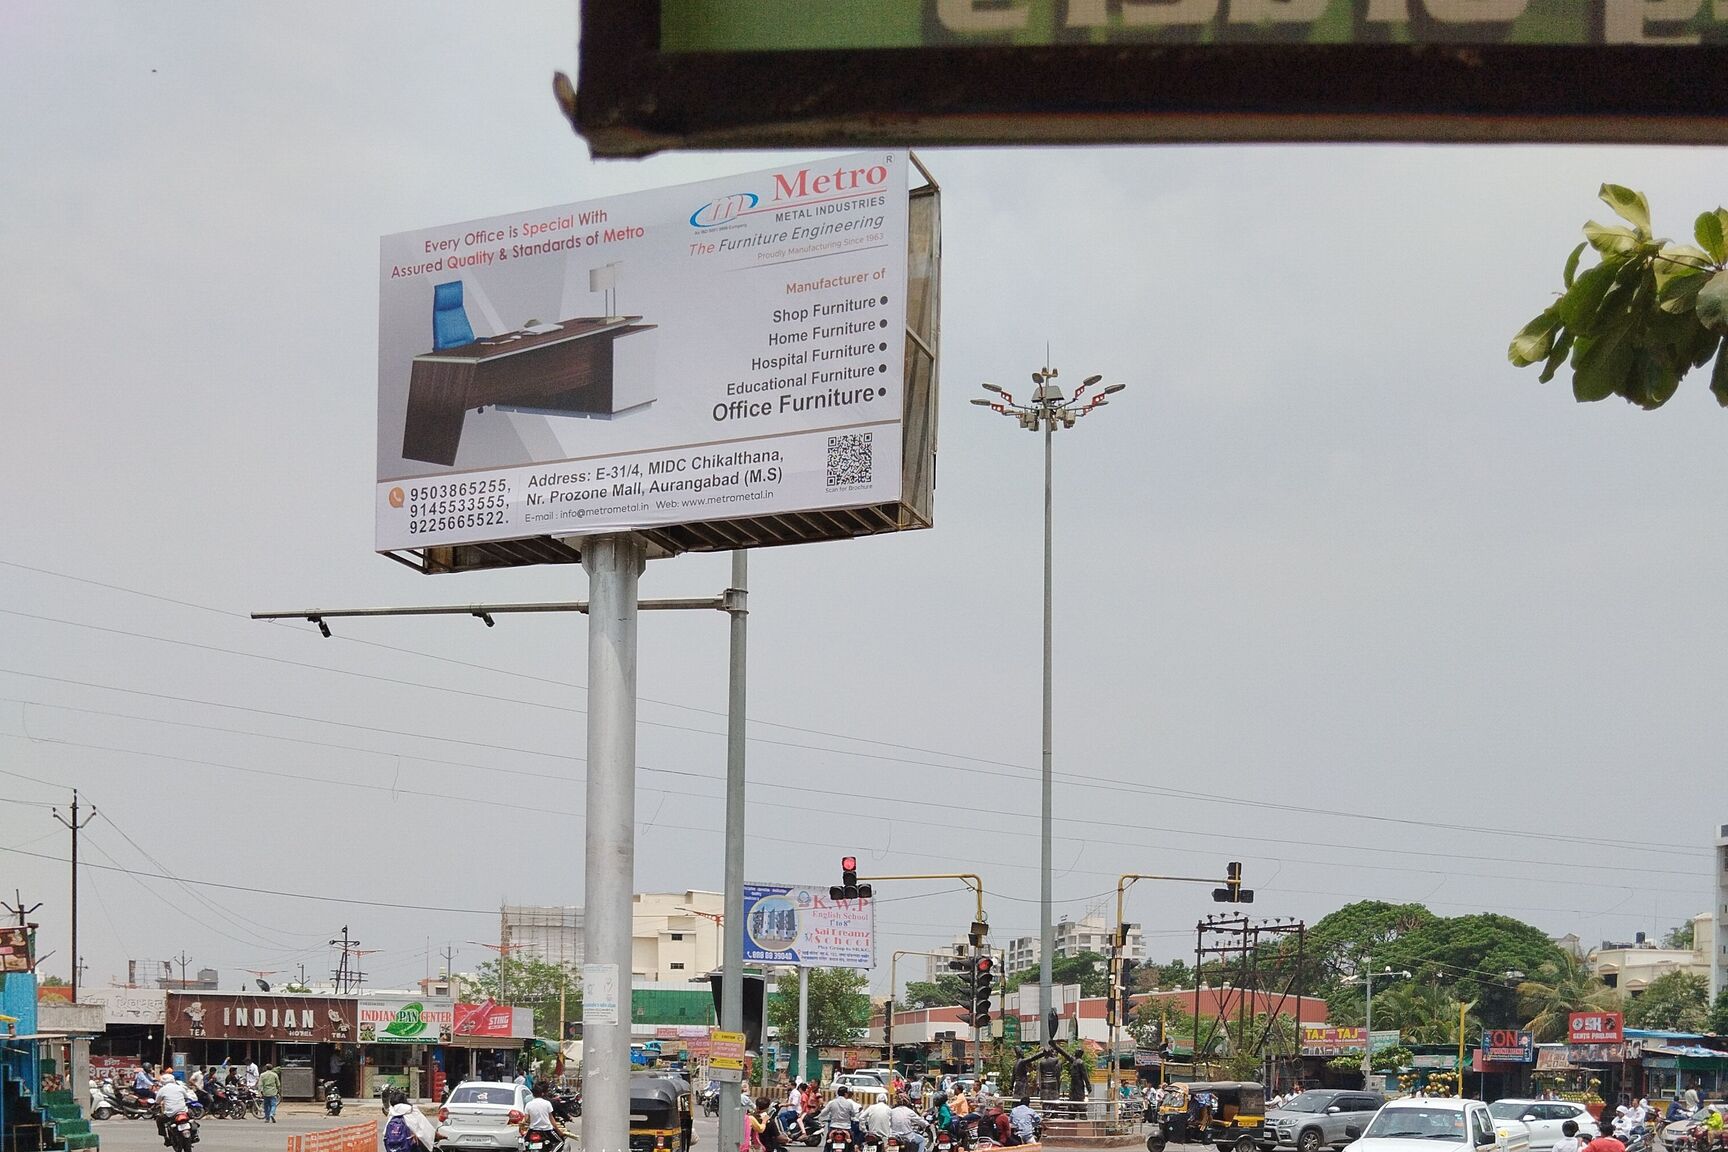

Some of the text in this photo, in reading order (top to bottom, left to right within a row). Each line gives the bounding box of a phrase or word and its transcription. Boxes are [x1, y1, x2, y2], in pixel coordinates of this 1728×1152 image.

[772, 165, 887, 201] Metro
[775, 196, 886, 223] METAL INDUSTRIES
[425, 209, 608, 253] Every Office is Special With
[689, 215, 885, 257] The Furniture Engineering
[391, 226, 645, 279] Assured Quality & Standards of Metro
[757, 250, 787, 261] Proudly
[788, 240, 842, 256] Manufacturing
[843, 236, 864, 247] Since
[786, 268, 886, 295] Manufacturer of
[772, 297, 877, 323] Shop Furniture
[768, 320, 876, 347] Home Furniture
[751, 343, 875, 371] Hospital Furniture
[727, 366, 875, 396] Educational Furniture
[712, 386, 875, 422] Office Furniture
[528, 450, 784, 488] Address: E-31/4, MIDC Chikalthana,
[410, 478, 511, 502] 9503865255,
[526, 467, 783, 506] Nr. Prozone Mall, Aurangabad (M.S)
[848, 483, 873, 492] Brochure
[410, 494, 510, 518] 9145533555,
[560, 501, 649, 519] info@metrometal.in
[656, 499, 680, 511] Web:
[682, 490, 774, 507] www.metrometal.in
[409, 511, 509, 534] 9225665522.
[812, 910, 868, 921] English School
[223, 1007, 314, 1029] INDIAN
[361, 1010, 452, 1023] INDIAN PAN CENTER
[488, 1015, 510, 1026] STING
[189, 1028, 207, 1037] TEA
[1305, 1028, 1326, 1039] TAJ
[1337, 1028, 1358, 1039] TAJ
